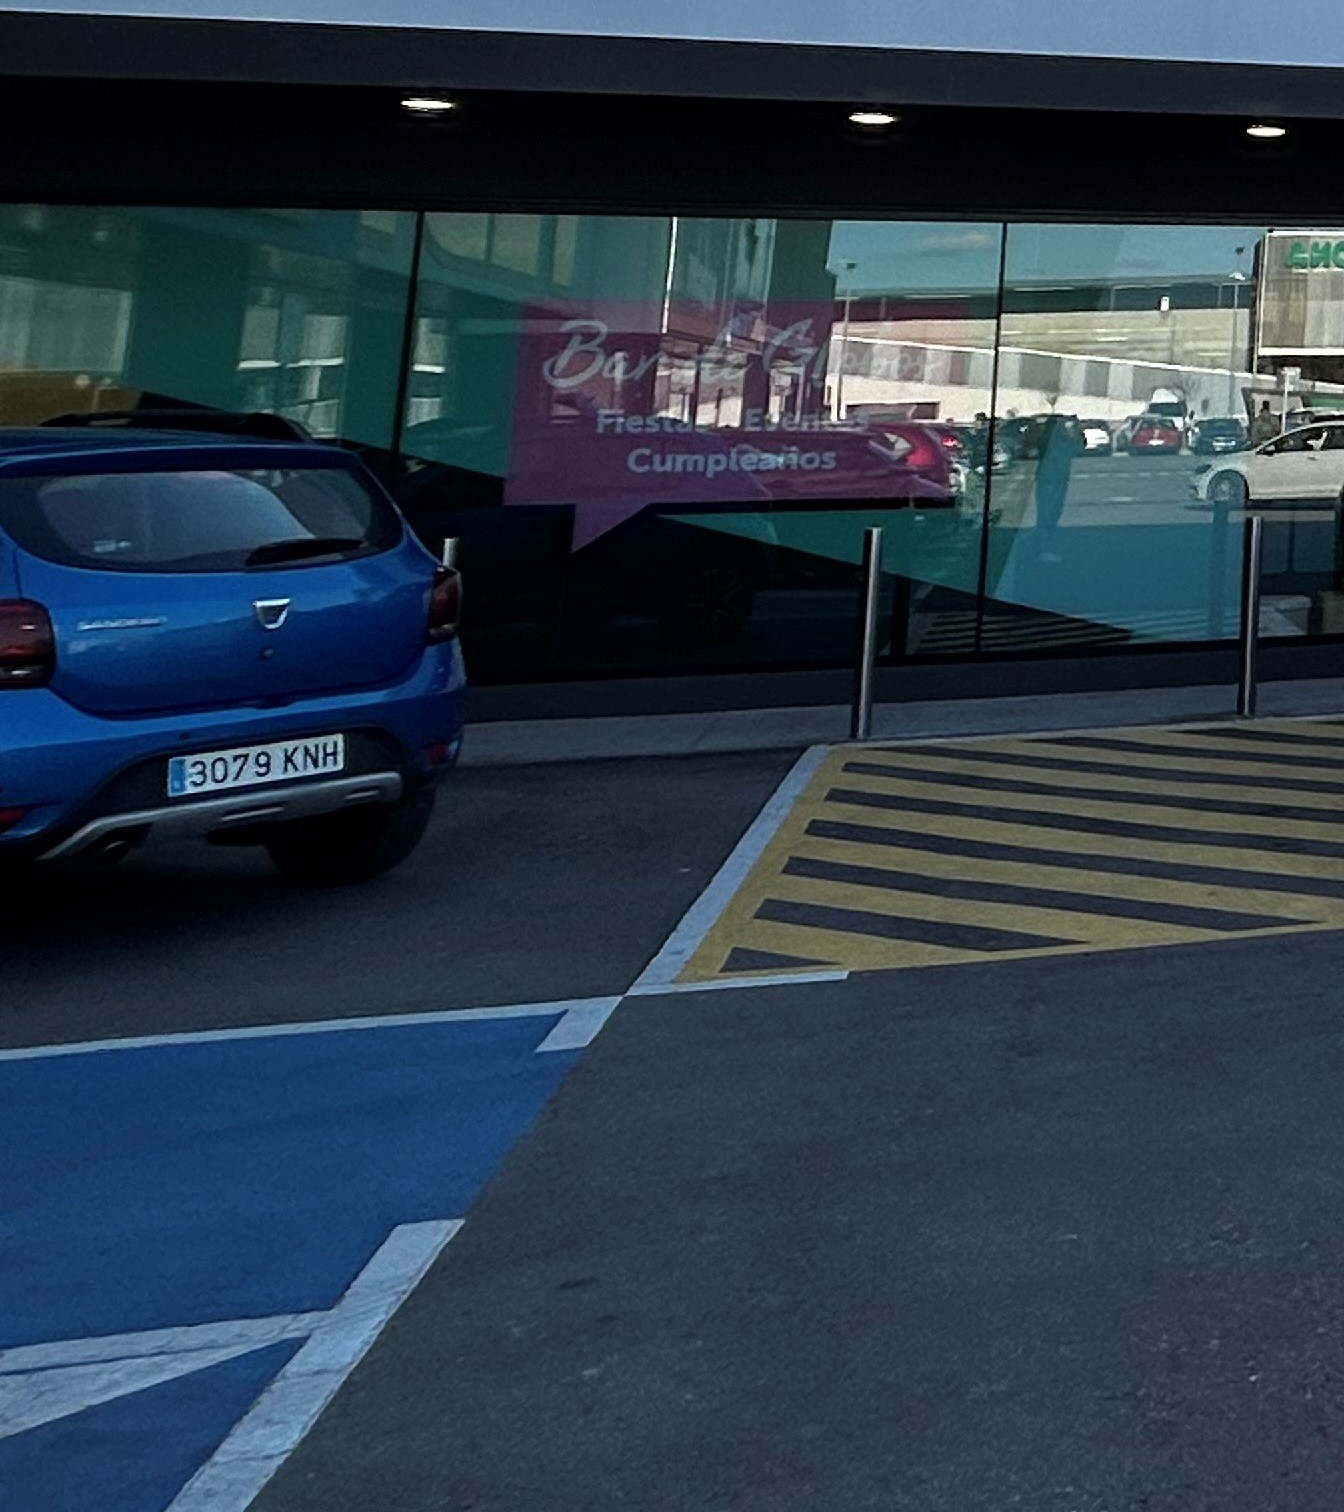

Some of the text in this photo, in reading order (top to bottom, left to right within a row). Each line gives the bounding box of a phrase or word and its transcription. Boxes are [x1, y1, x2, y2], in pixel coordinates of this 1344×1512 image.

[542, 318, 660, 389] Bar
[627, 445, 836, 478] Cumpleaños
[188, 741, 339, 787] 3079 KNH
